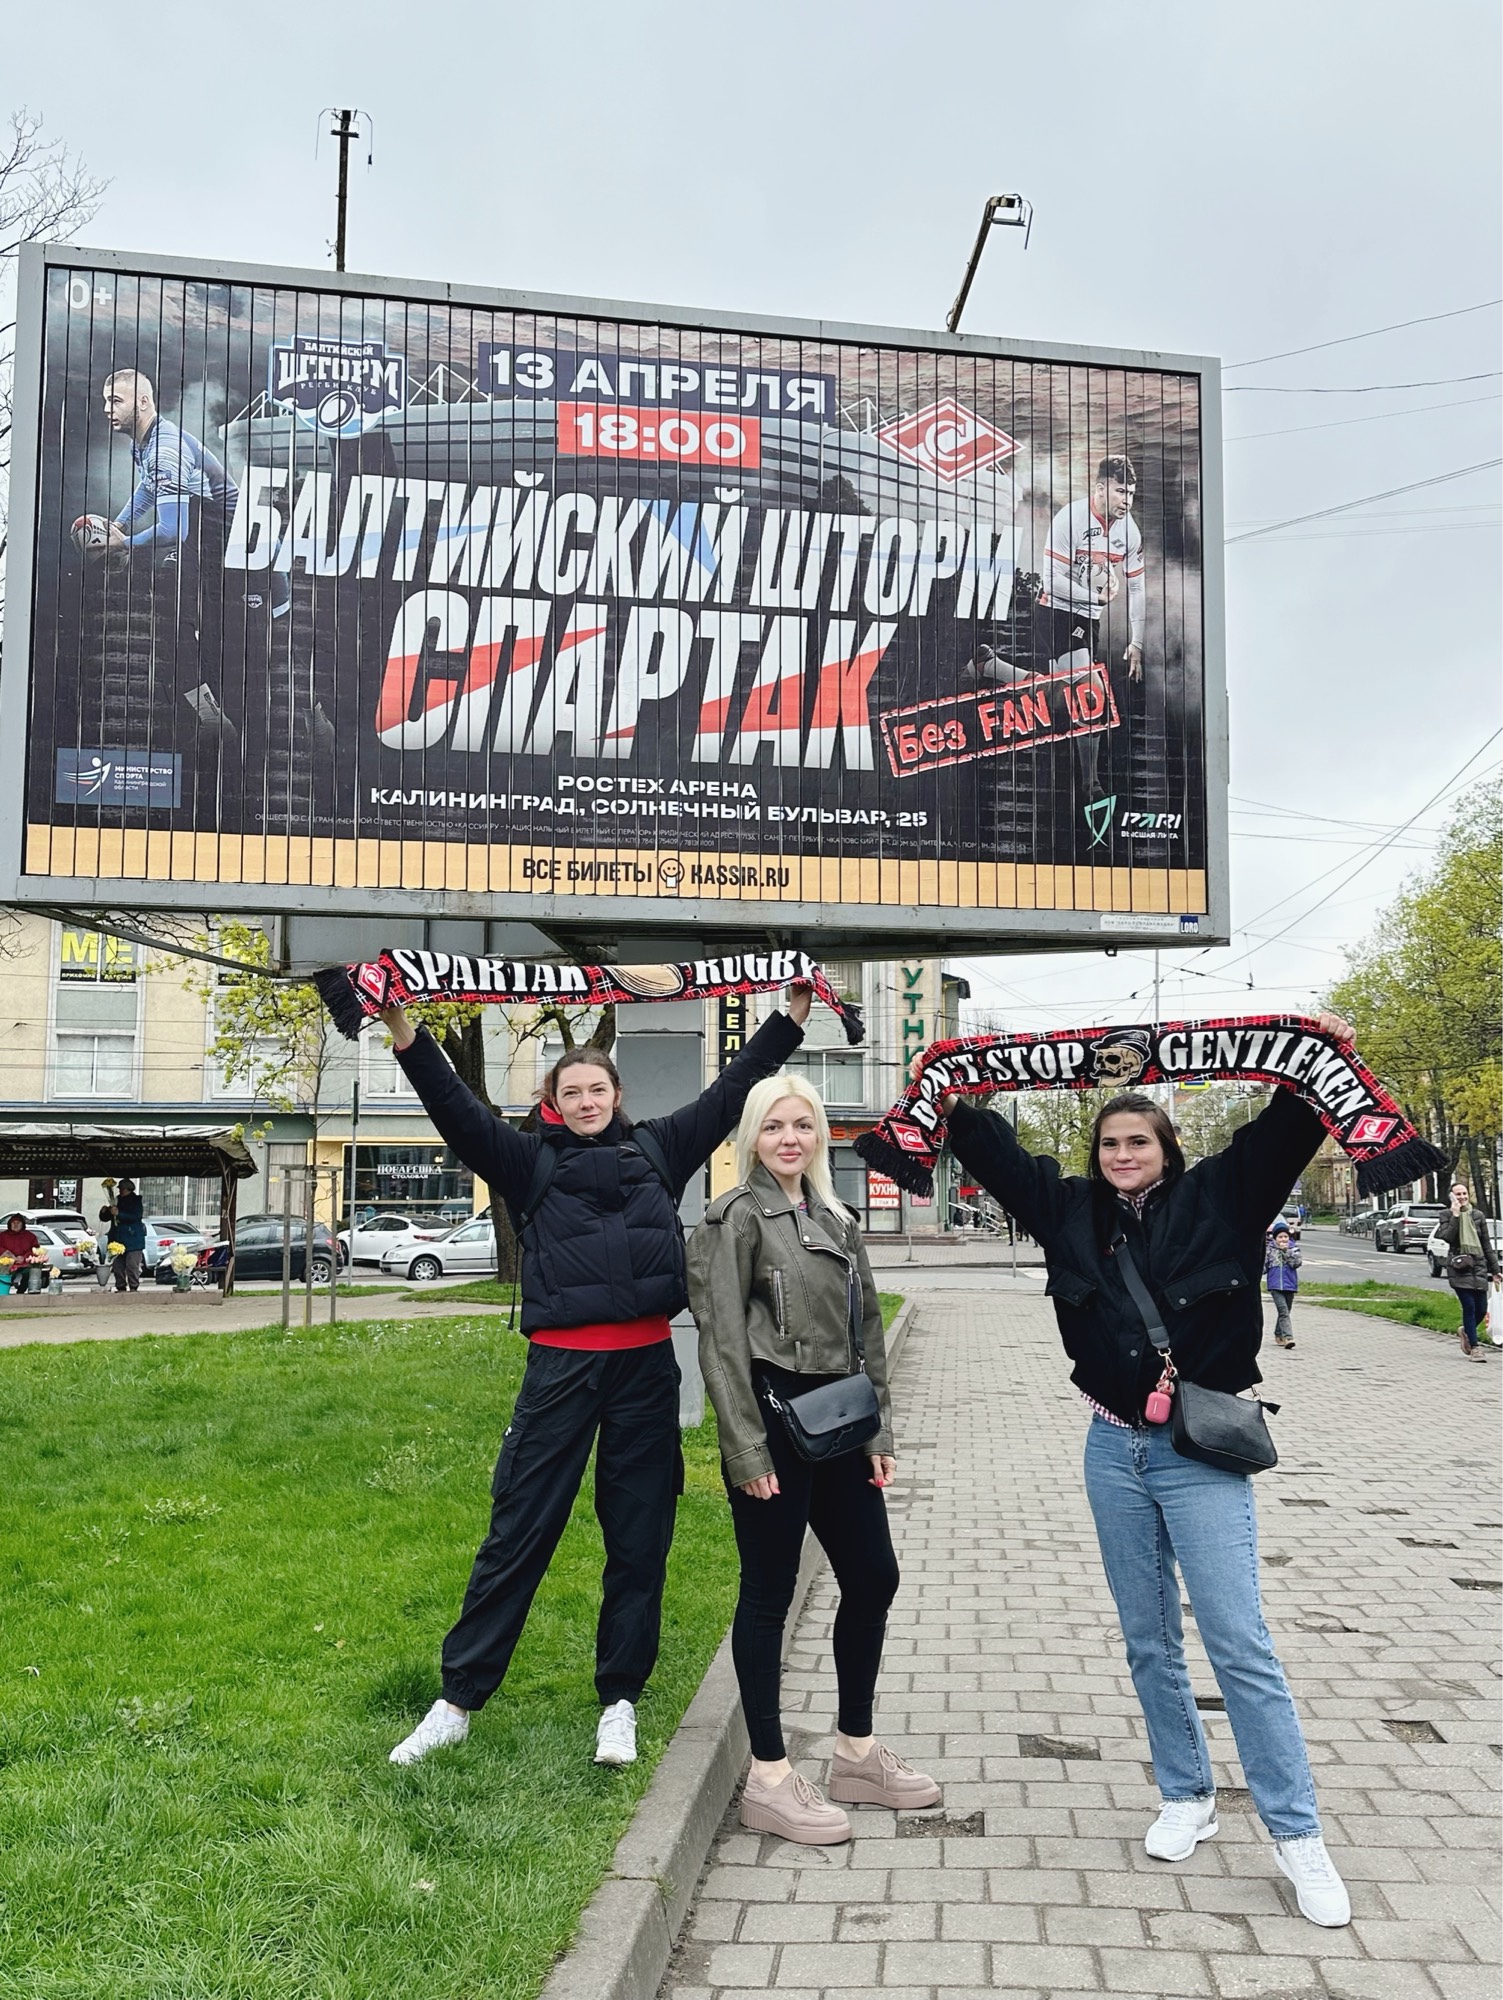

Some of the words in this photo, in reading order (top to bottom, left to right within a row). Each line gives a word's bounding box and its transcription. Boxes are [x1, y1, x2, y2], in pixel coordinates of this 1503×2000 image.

[65, 278, 112, 309] 0+
[304, 342, 374, 356] БАЛТИЙСКИЙ
[278, 352, 399, 400] ШТОРМ
[489, 350, 554, 390] 13
[569, 359, 826, 414] АПРЕЛЯ
[573, 412, 747, 458] 18:00
[223, 464, 750, 604] БАЛТИЙСКИЙ
[748, 506, 1024, 622] ШТОРМ
[375, 588, 898, 771] СПАРТАК
[893, 720, 967, 764] Без
[978, 690, 1051, 742] FAN
[1063, 683, 1105, 723] ID
[114, 766, 173, 775] МИНИСТЕРСТВО
[558, 775, 664, 795] РОСТЕХ
[670, 780, 757, 799] АРЕНА
[371, 787, 586, 816] КАЛИНИНГРАД,
[590, 799, 760, 820] СОЛНЕЧНЫЙ
[767, 806, 891, 828] БУЛЬВАР,
[896, 811, 928, 828] 25
[1120, 811, 1182, 829] PARI
[1121, 830, 1156, 839] ВЫСШАЯ
[522, 858, 561, 881] ВСЕ
[567, 860, 652, 883] БИЛЕТЫ
[691, 864, 790, 887] KASSIR.RU
[986, 1041, 1085, 1082] STOP
[1159, 1030, 1374, 1118] GENTLEMEN
[869, 1183, 899, 1196] КУХНИ
